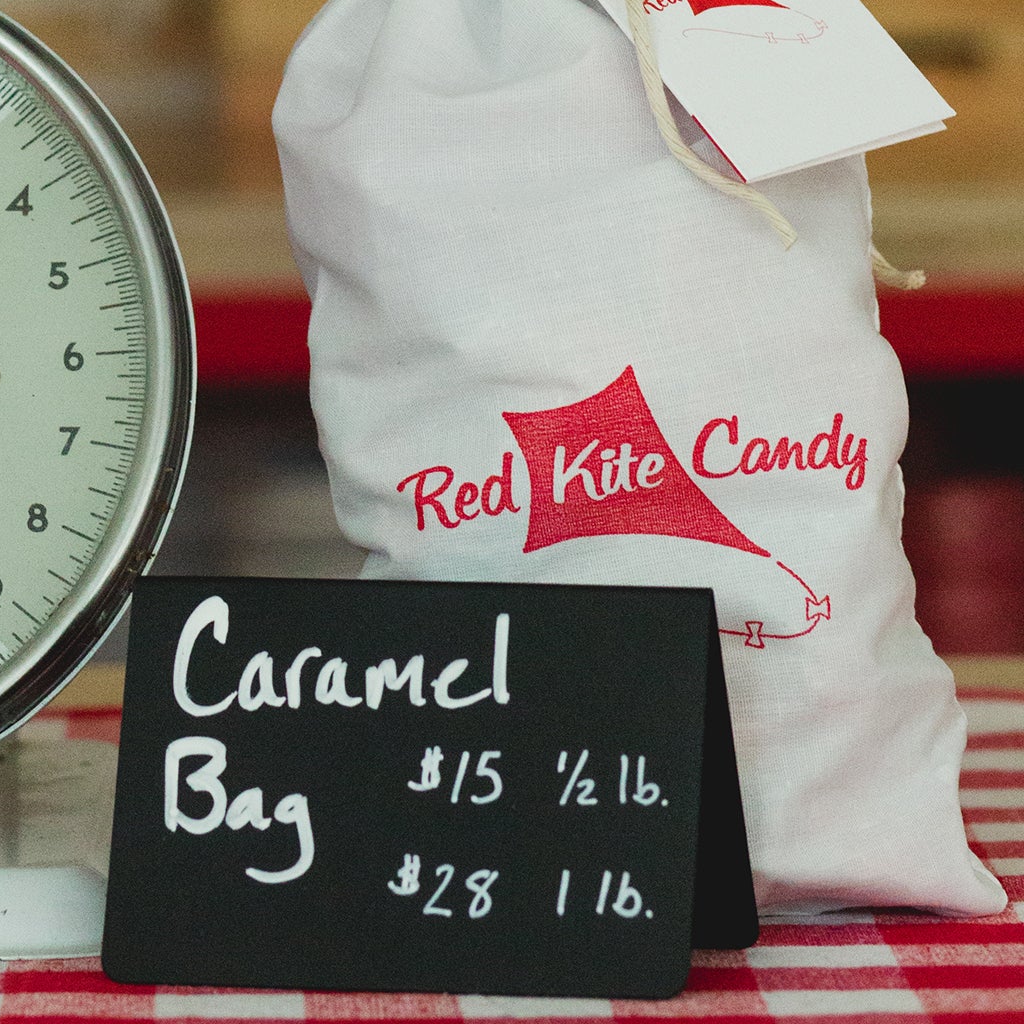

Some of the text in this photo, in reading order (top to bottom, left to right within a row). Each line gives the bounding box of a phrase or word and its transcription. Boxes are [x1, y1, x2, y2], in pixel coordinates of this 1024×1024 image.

[5, 184, 34, 216] 4
[48, 261, 69, 290] 5
[63, 342, 84, 372] 6
[59, 426, 80, 456] 7
[396, 413, 868, 531] Red Kite Candy
[27, 503, 49, 533] 8
[173, 595, 510, 717] Caramel
[407, 745, 503, 804] $15
[619, 753, 669, 807] lb.
[164, 736, 315, 884] Bag
[387, 853, 654, 919] $28 1 lb.
